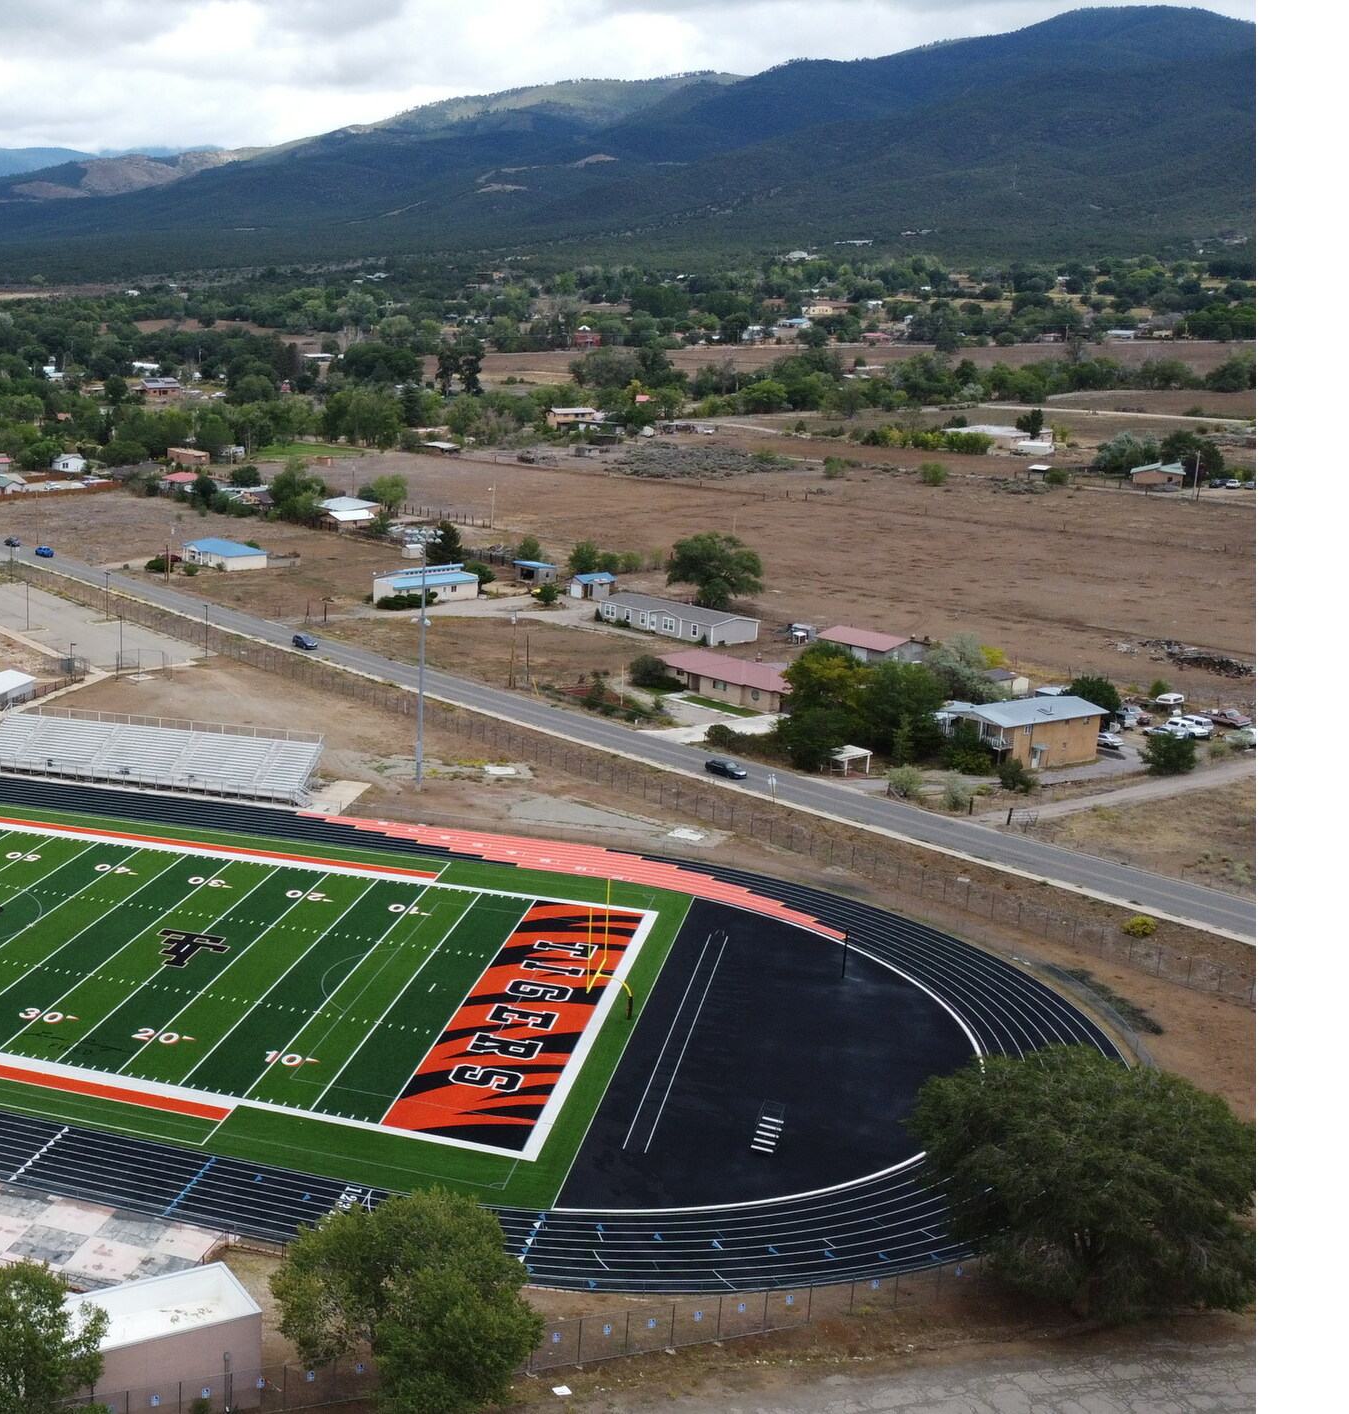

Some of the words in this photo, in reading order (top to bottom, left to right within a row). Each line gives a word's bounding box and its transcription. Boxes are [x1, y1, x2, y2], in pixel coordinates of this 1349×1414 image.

[5, 851, 42, 863] 50
[94, 863, 131, 876] 40
[188, 876, 226, 888] 30
[285, 889, 326, 902] 20
[388, 903, 421, 915] 10
[19, 1007, 64, 1023] 30
[448, 939, 598, 1092] TIGERS
[131, 1027, 181, 1044] 20
[264, 1050, 304, 1067] 10
